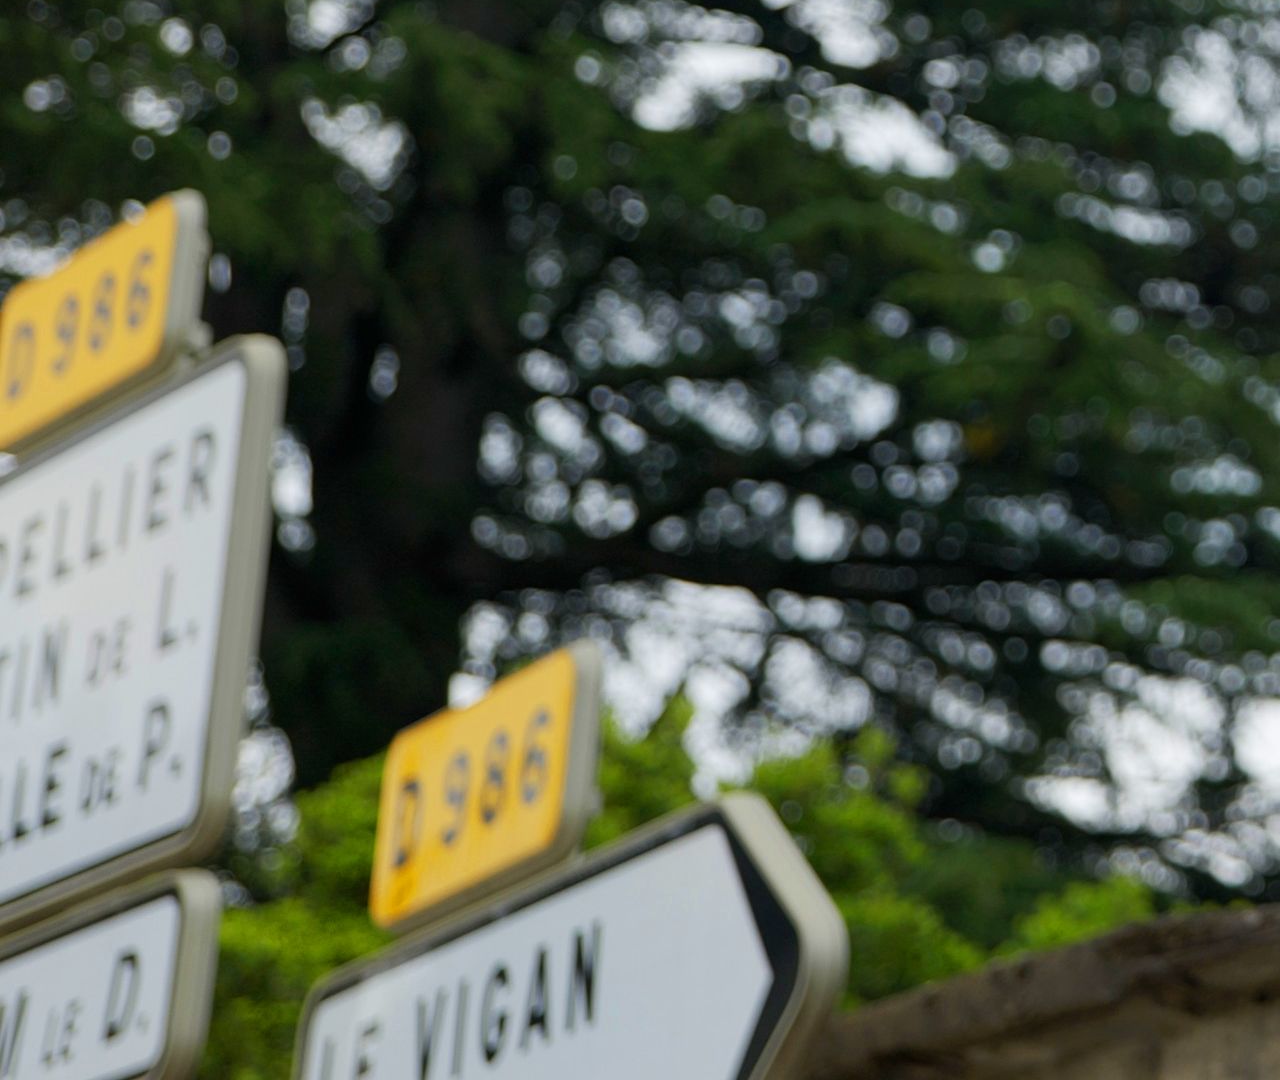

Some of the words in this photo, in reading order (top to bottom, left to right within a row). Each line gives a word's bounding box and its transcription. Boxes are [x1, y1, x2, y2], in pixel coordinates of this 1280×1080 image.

[5, 319, 37, 404] D
[51, 249, 155, 377] 986
[0, 739, 72, 850] LE
[393, 778, 422, 869] D
[441, 705, 553, 846] 986
[416, 916, 605, 1080] VIGAN
